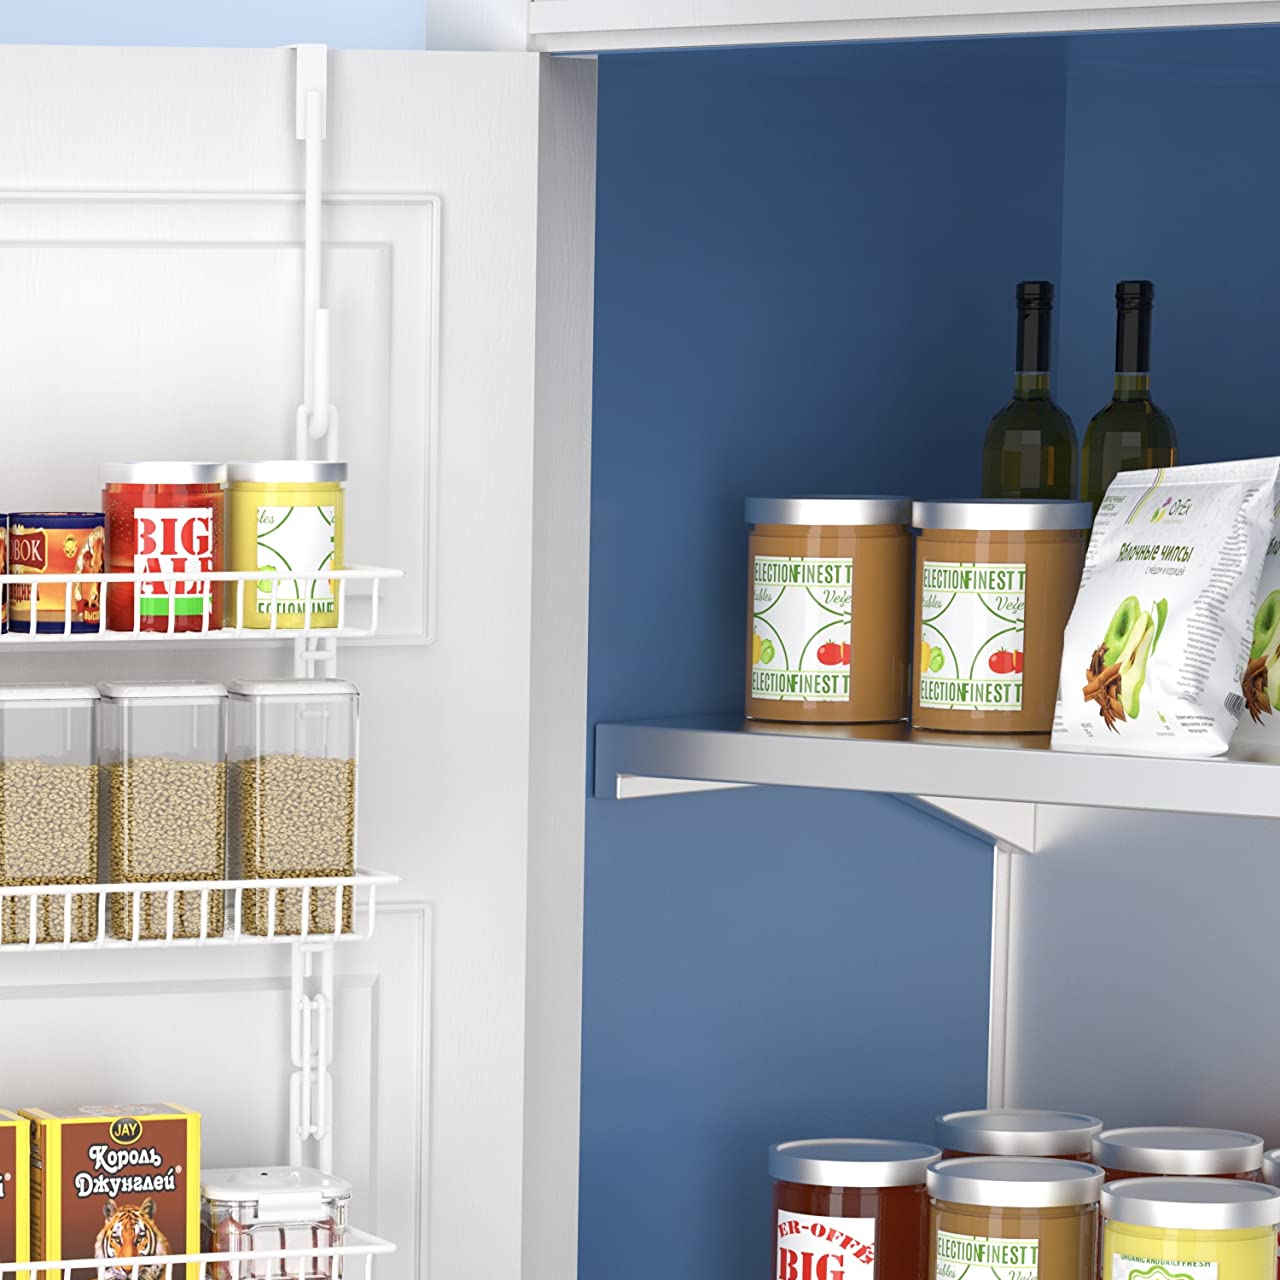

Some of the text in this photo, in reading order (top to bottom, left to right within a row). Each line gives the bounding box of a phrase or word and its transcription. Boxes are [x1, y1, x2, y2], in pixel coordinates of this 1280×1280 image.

[134, 517, 209, 555] BIG
[114, 1123, 138, 1137] JAY
[88, 1145, 162, 1174] Король
[75, 1168, 175, 1197] Джунглей
